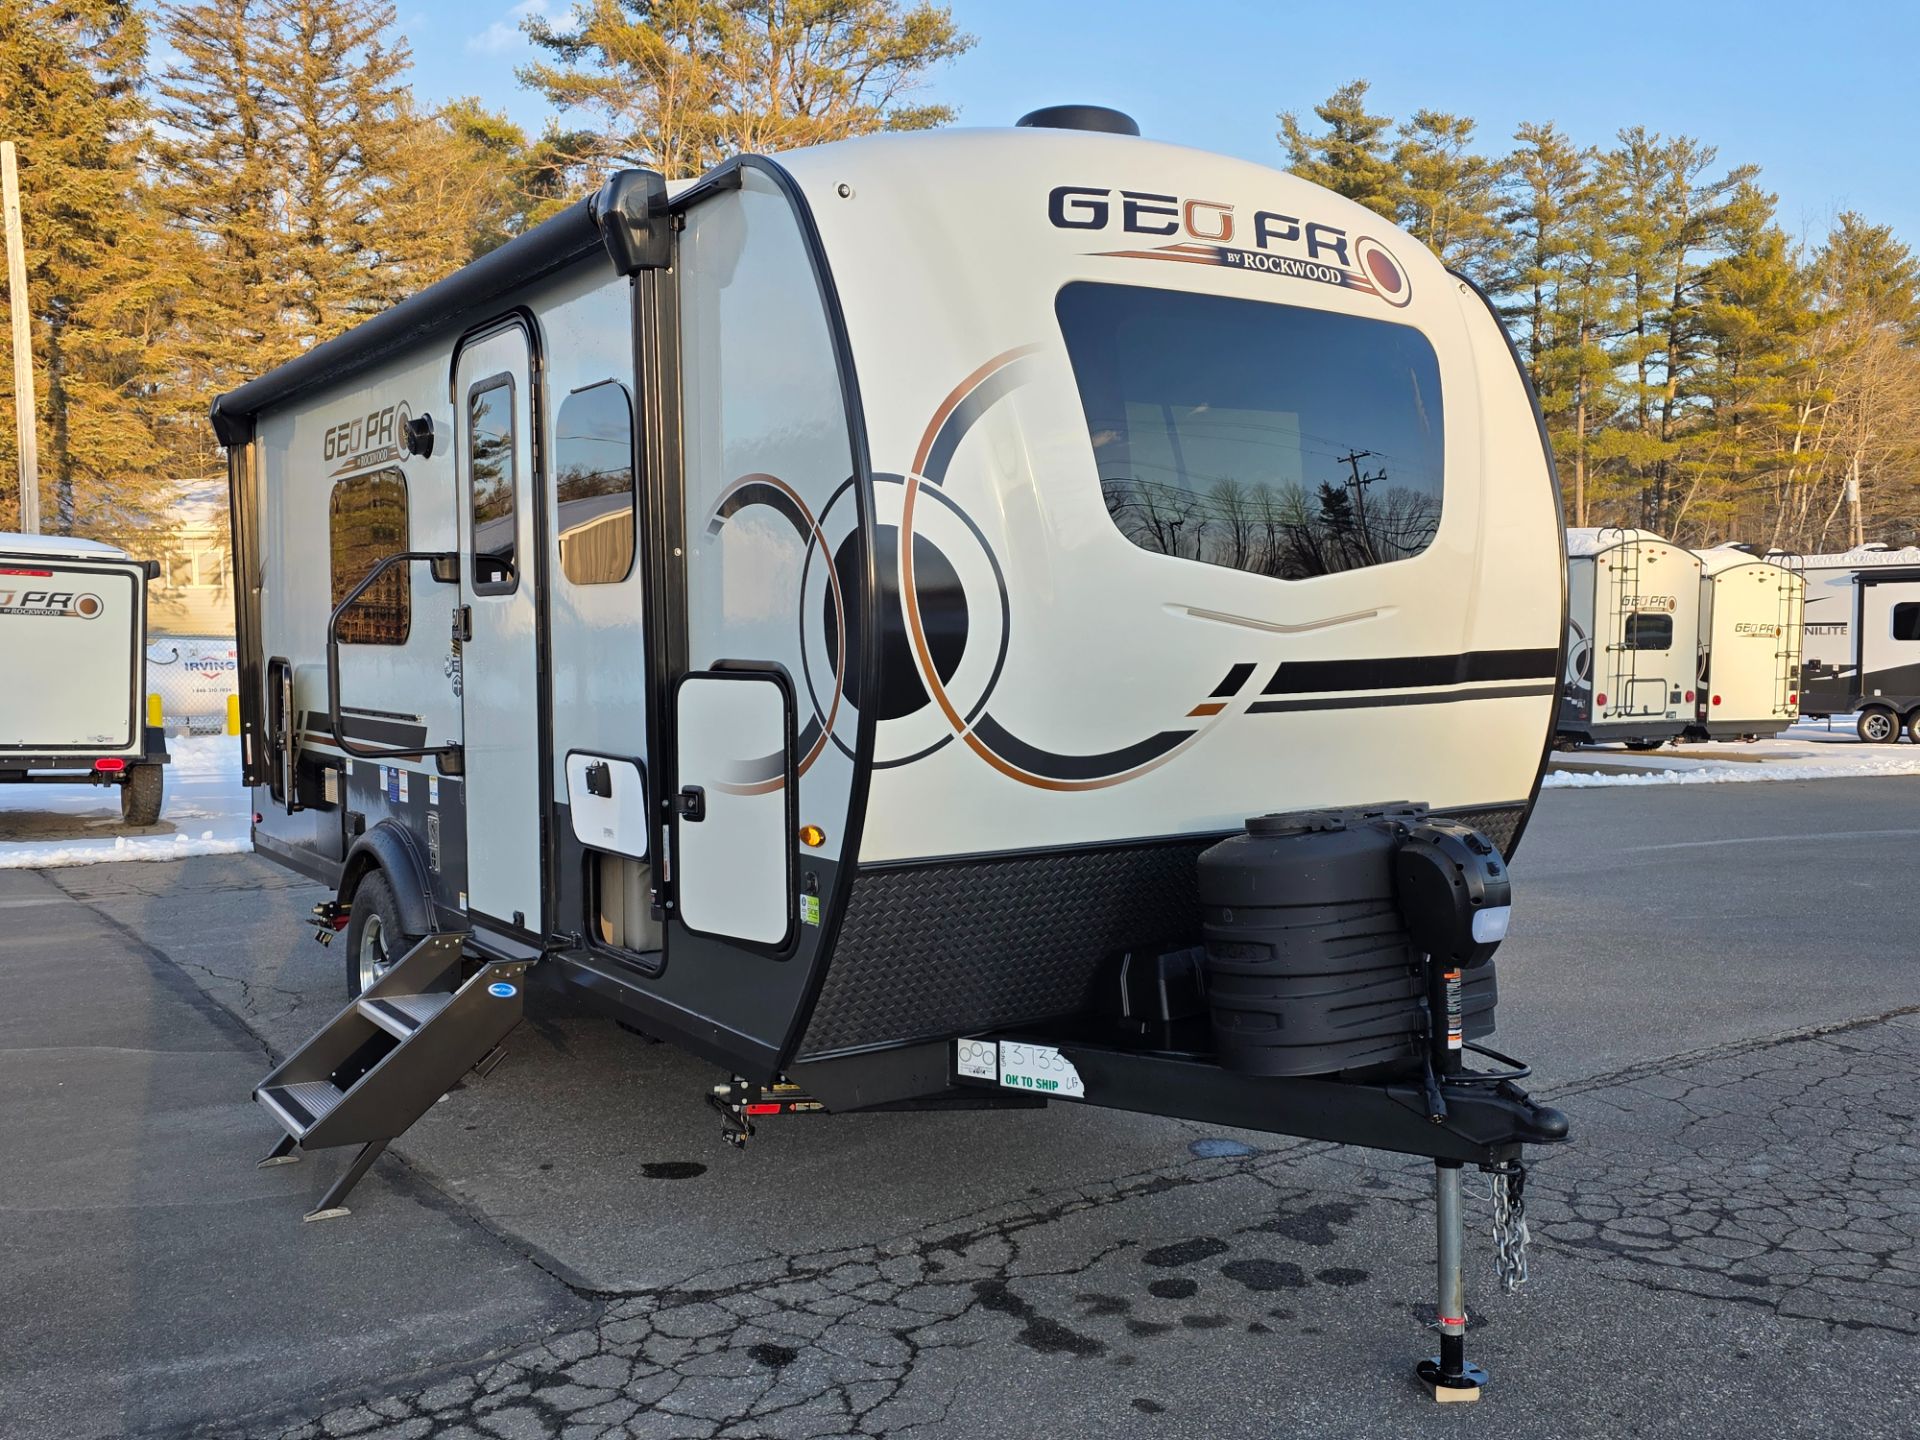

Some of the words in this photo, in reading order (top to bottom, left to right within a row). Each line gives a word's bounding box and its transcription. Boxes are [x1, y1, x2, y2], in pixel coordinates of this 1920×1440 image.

[1048, 186, 1235, 243] GEO
[1254, 210, 1413, 308] PRO
[1227, 252, 1241, 263] BY
[1242, 252, 1341, 284] ROCKWOOD
[324, 417, 363, 461] GEO
[11, 608, 60, 616] ROCKWOOD
[20, 591, 104, 620] PRO
[1804, 627, 1847, 635] NILITE
[185, 661, 236, 671] IRVING
[1011, 1045, 1071, 1072] 3733
[1005, 1074, 1019, 1085] OK
[1022, 1076, 1033, 1087] TO
[1036, 1078, 1059, 1091] SHIP
